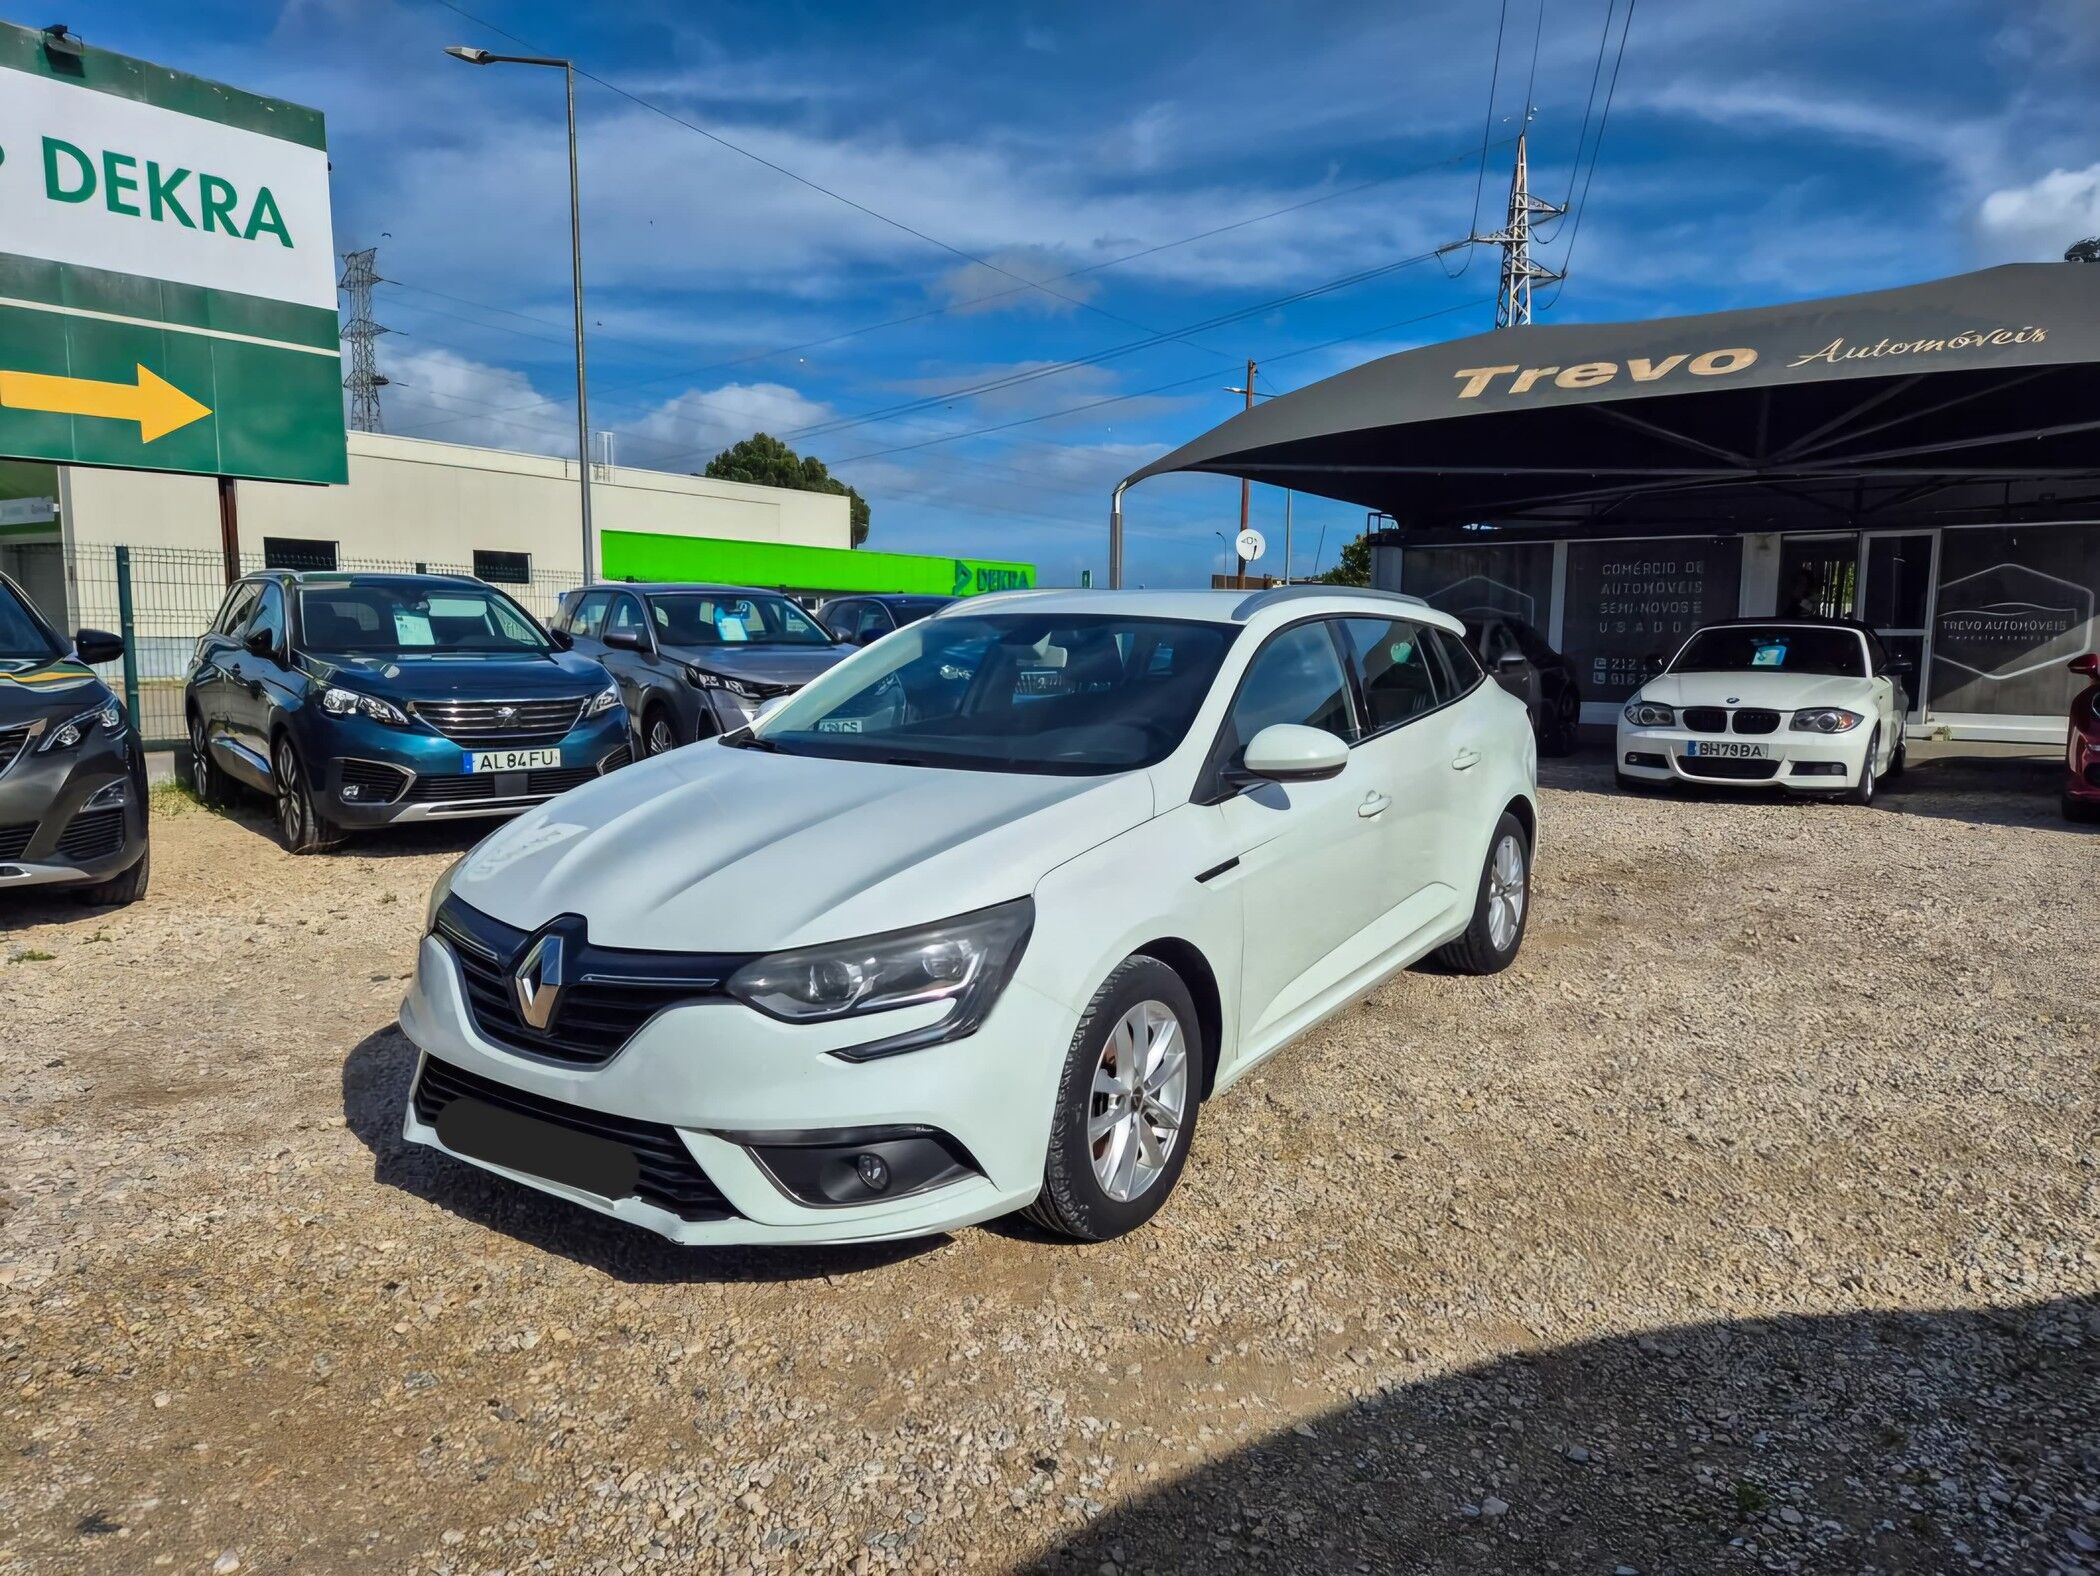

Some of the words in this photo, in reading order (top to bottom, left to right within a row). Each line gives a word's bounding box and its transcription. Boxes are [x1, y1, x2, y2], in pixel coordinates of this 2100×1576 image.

[41, 135, 294, 249] DEKRA
[1454, 348, 1758, 399] Trevo
[1786, 326, 2049, 368] Automóveis
[977, 568, 1029, 592] DEKRA
[1943, 620, 1982, 631] TREVO
[480, 751, 554, 770] AL84FU
